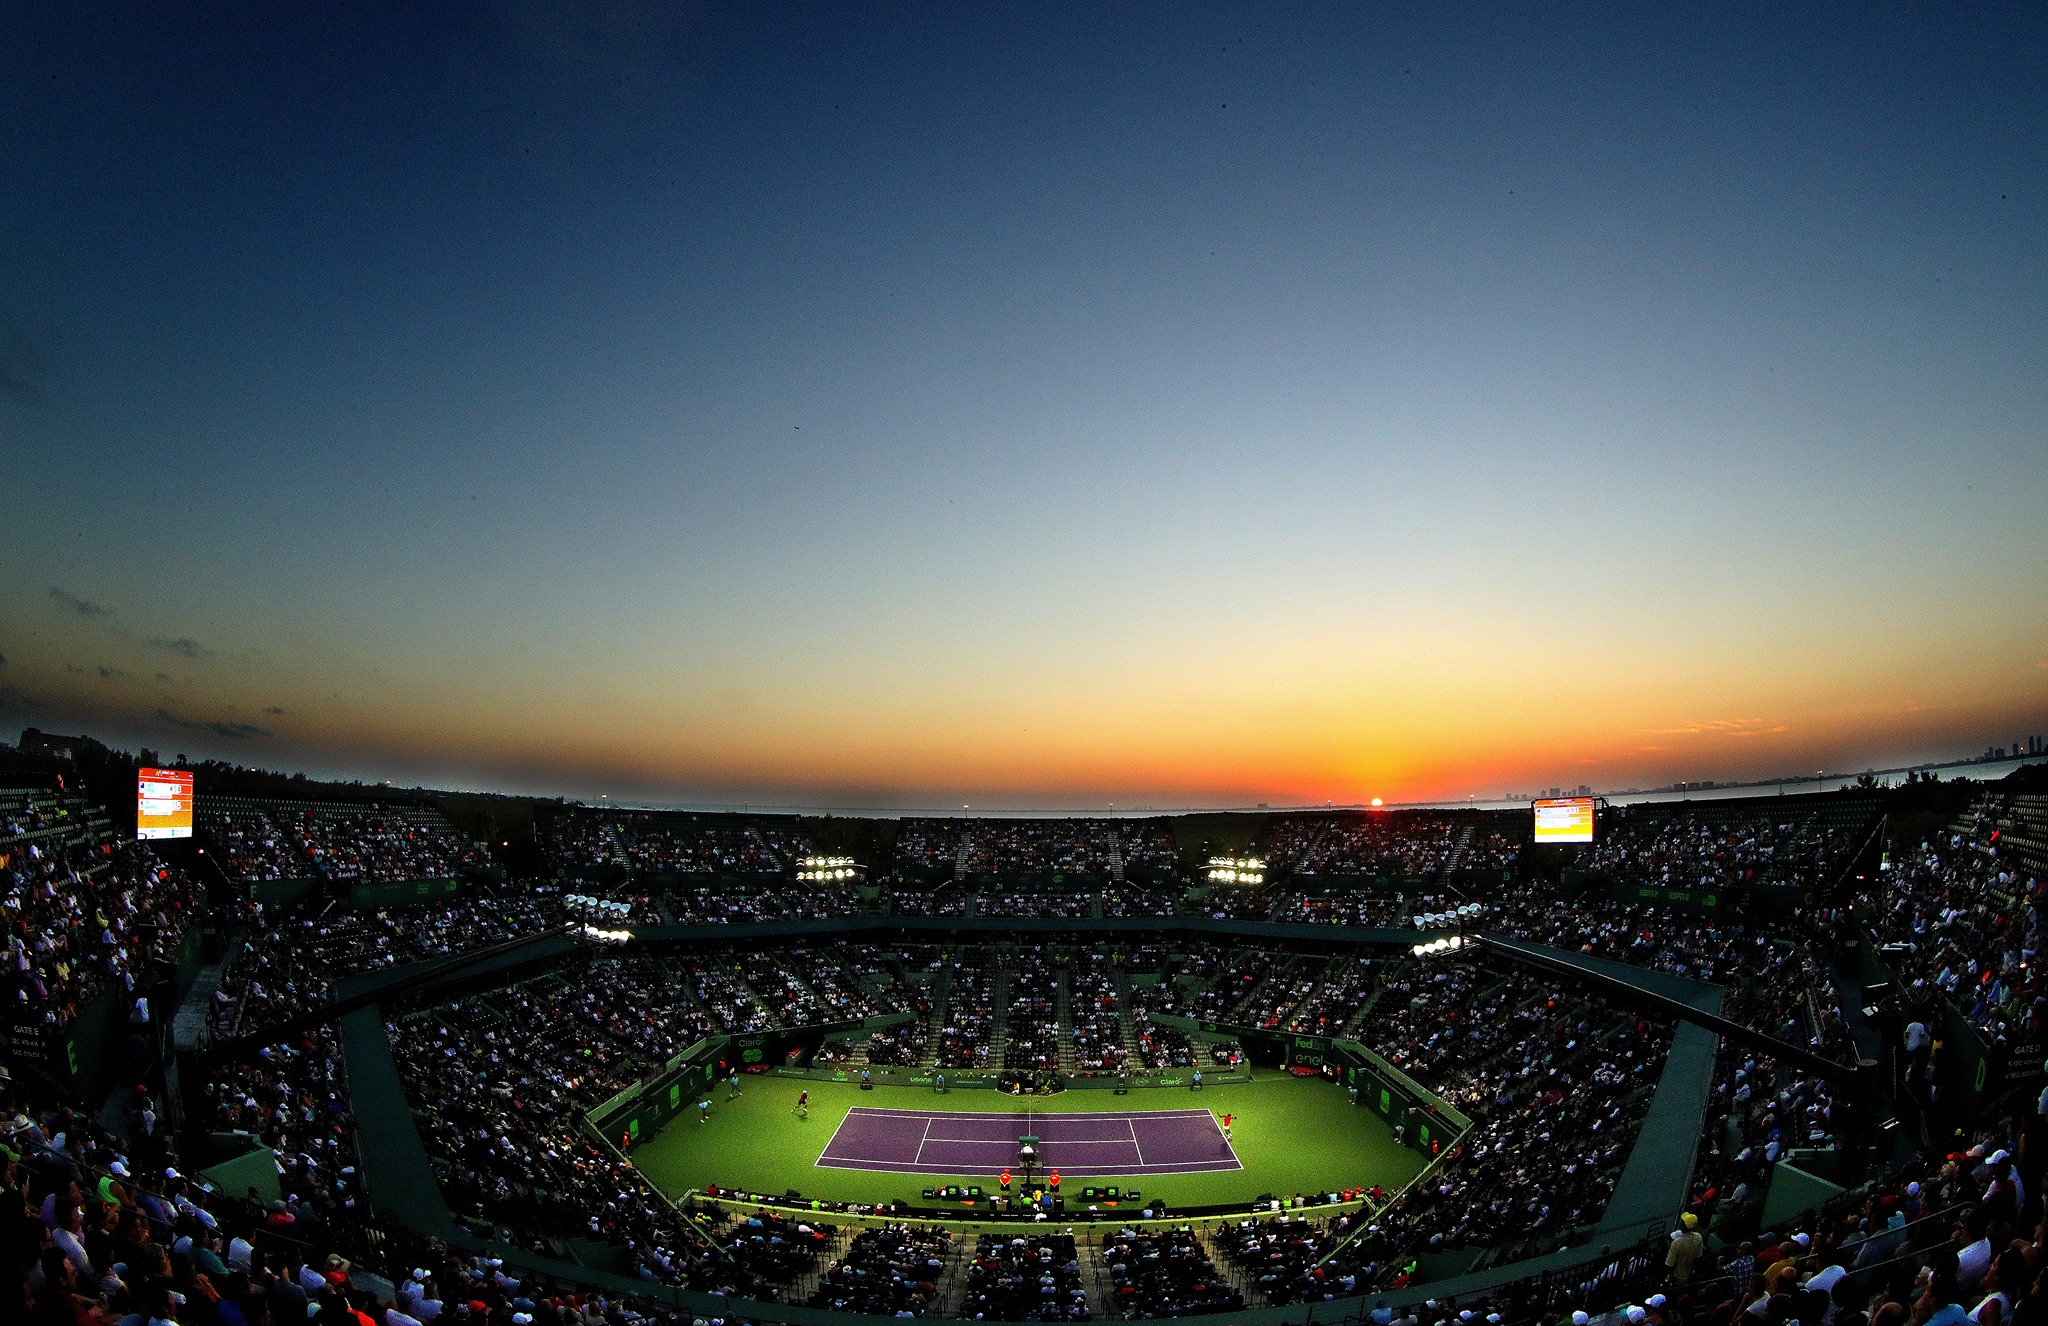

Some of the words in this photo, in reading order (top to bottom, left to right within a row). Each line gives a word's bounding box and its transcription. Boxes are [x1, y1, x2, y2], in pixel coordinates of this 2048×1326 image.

[250, 885, 257, 898] F
[14, 1025, 33, 1035] GATE
[738, 1039, 762, 1047] Claro
[1295, 1038, 1326, 1051] FedEx
[2015, 1045, 2034, 1054] GATE
[67, 1040, 78, 1075] E
[1295, 1055, 1323, 1066] enel
[1160, 1077, 1180, 1086] Claro
